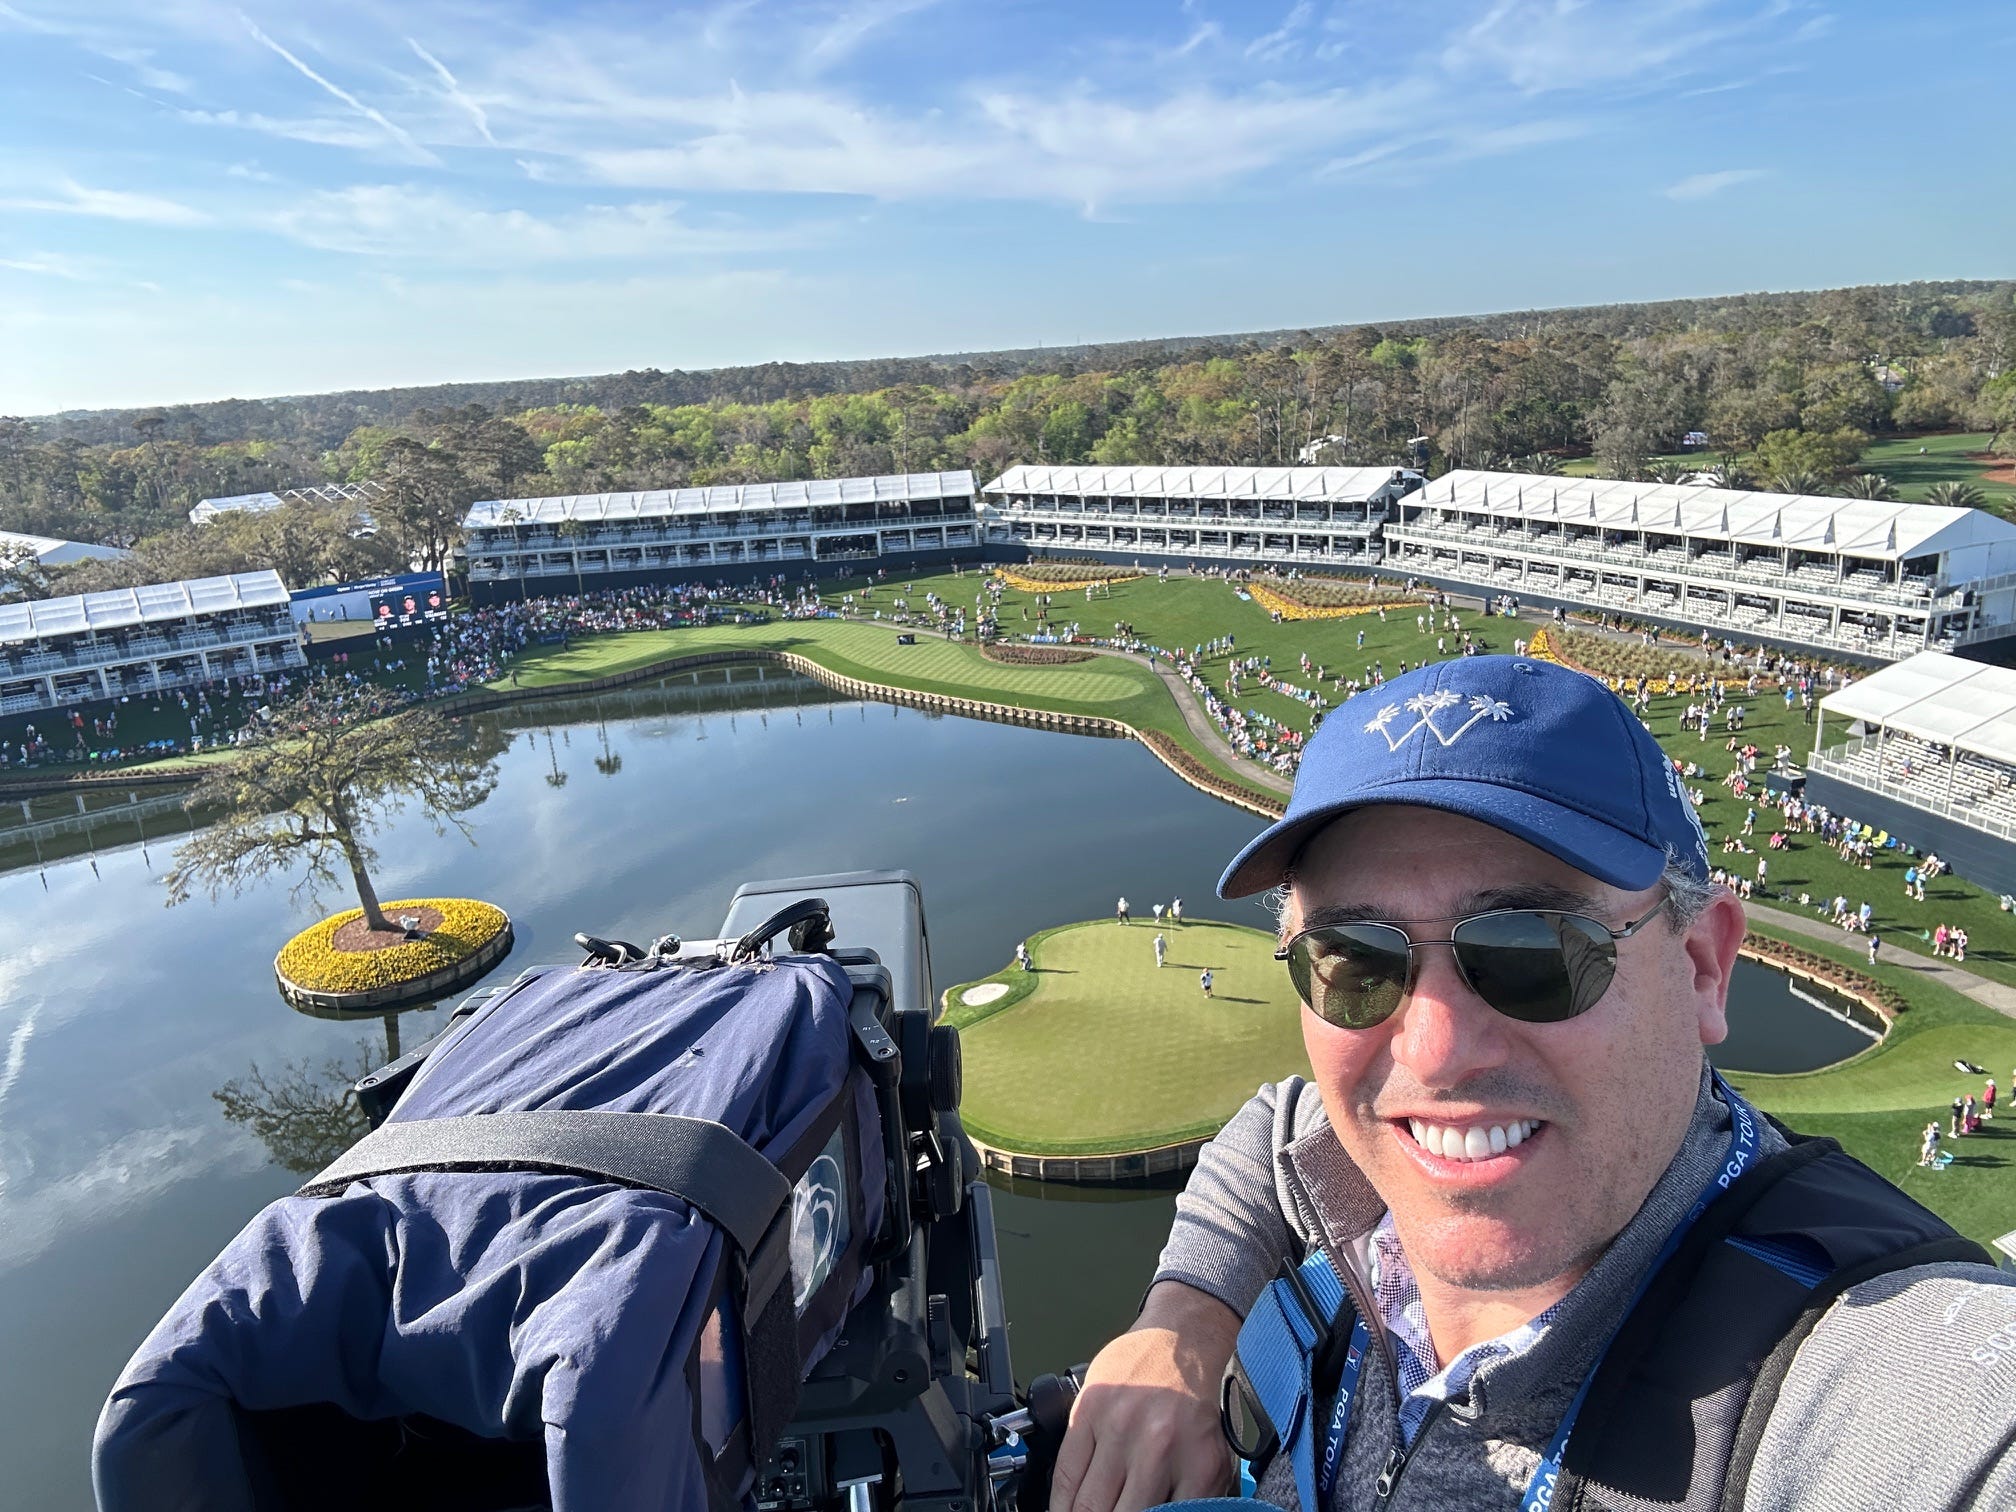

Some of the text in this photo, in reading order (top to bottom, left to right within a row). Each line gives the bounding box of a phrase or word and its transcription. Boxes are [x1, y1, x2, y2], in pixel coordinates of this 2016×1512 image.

[1718, 1103, 1754, 1189] PGA TOUR
[1319, 1387, 1349, 1492] PGA TOUR
